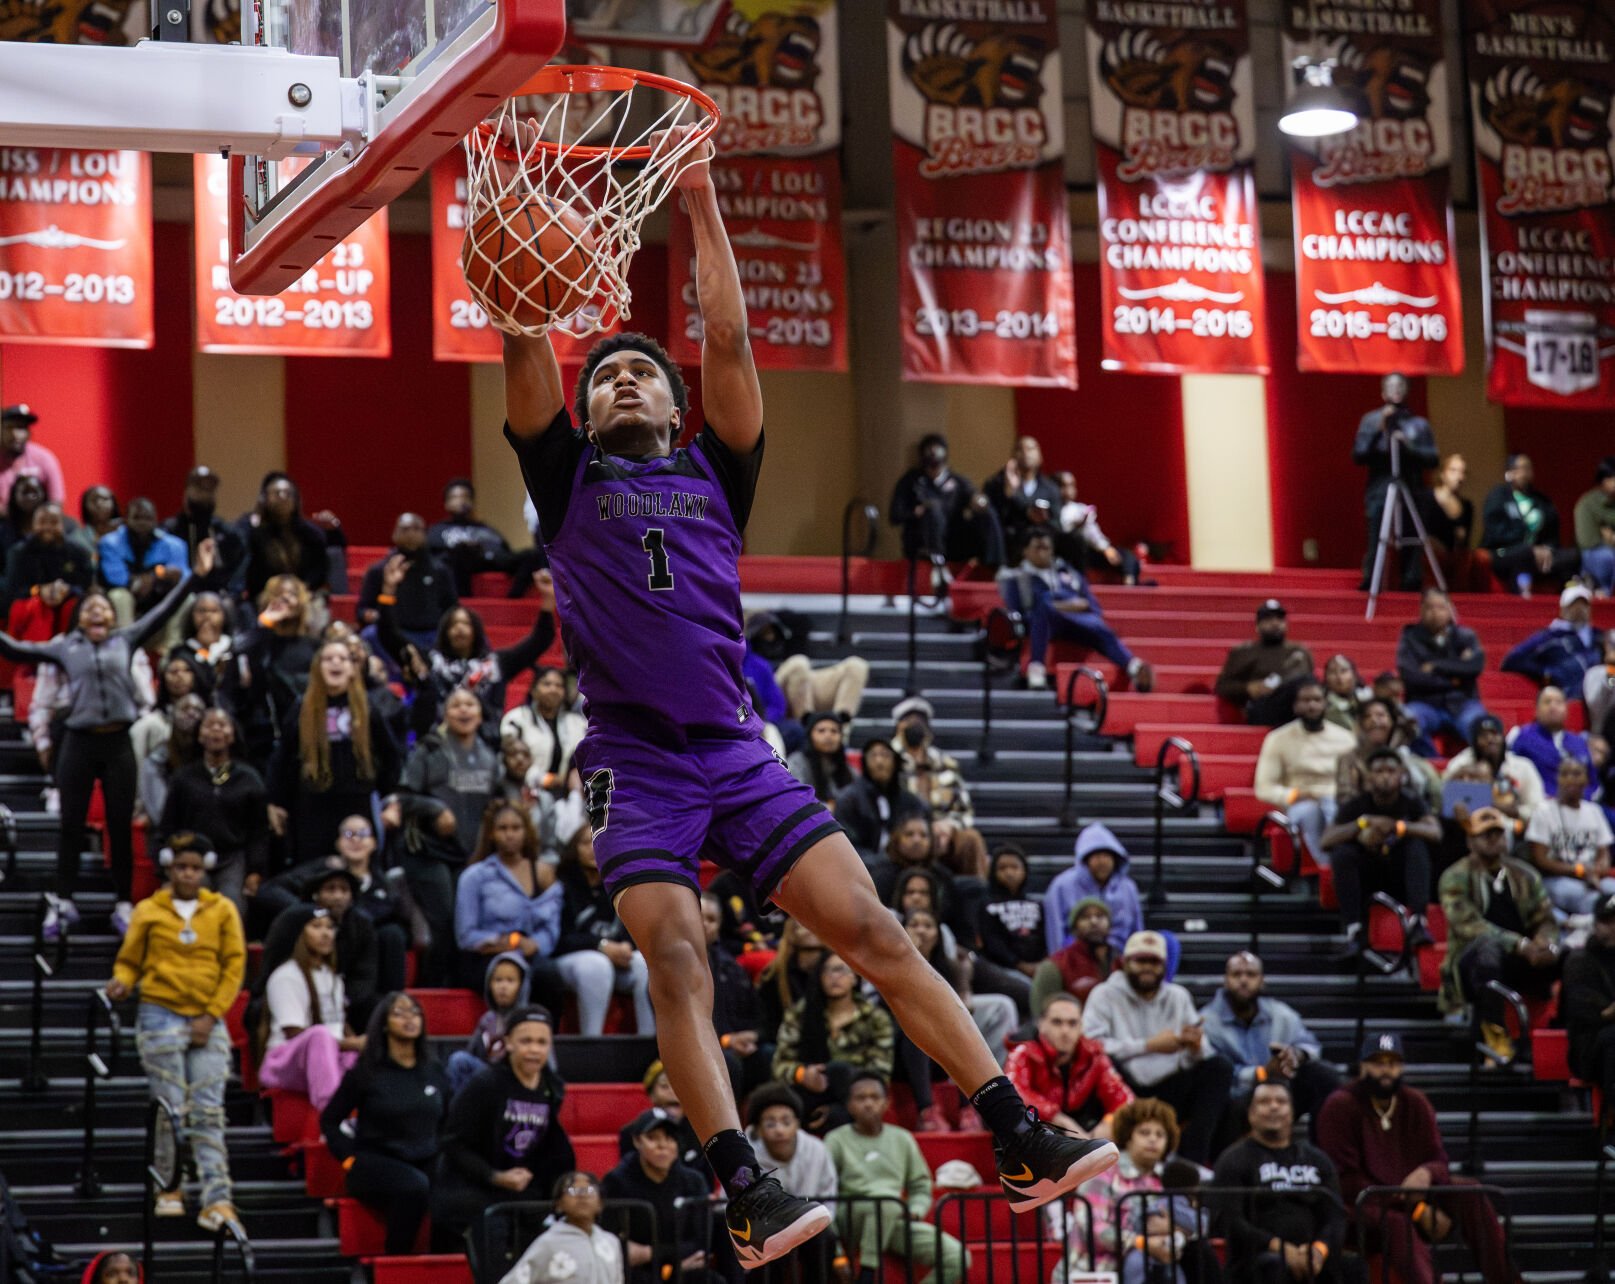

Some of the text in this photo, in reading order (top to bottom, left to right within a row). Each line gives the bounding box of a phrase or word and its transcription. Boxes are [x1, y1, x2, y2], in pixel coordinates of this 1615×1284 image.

[928, 104, 1044, 144] BRCC
[1125, 108, 1234, 150] BRCC
[0, 149, 39, 175] ISS
[1504, 145, 1609, 184] BRCC
[0, 176, 137, 206] AMPIONS
[1101, 218, 1254, 249] CONFERENCE
[1335, 208, 1412, 237] LCCAC
[1517, 226, 1592, 251] LCCAC
[908, 243, 1061, 272] CHAMPIONS
[1106, 243, 1253, 275] CHAMPIONS
[1302, 233, 1446, 265] CHAMPIONS
[1496, 250, 1615, 279] ONFERENC
[0, 270, 136, 305] 012-2013
[215, 296, 374, 329] 2012-2013
[915, 308, 1060, 338] 2013-2014
[1113, 304, 1254, 339] 2014-2015
[1310, 308, 1448, 342] 2015-2016
[684, 312, 833, 347] 2-2013
[597, 491, 709, 521] WOODLAWN
[641, 527, 675, 592] 1
